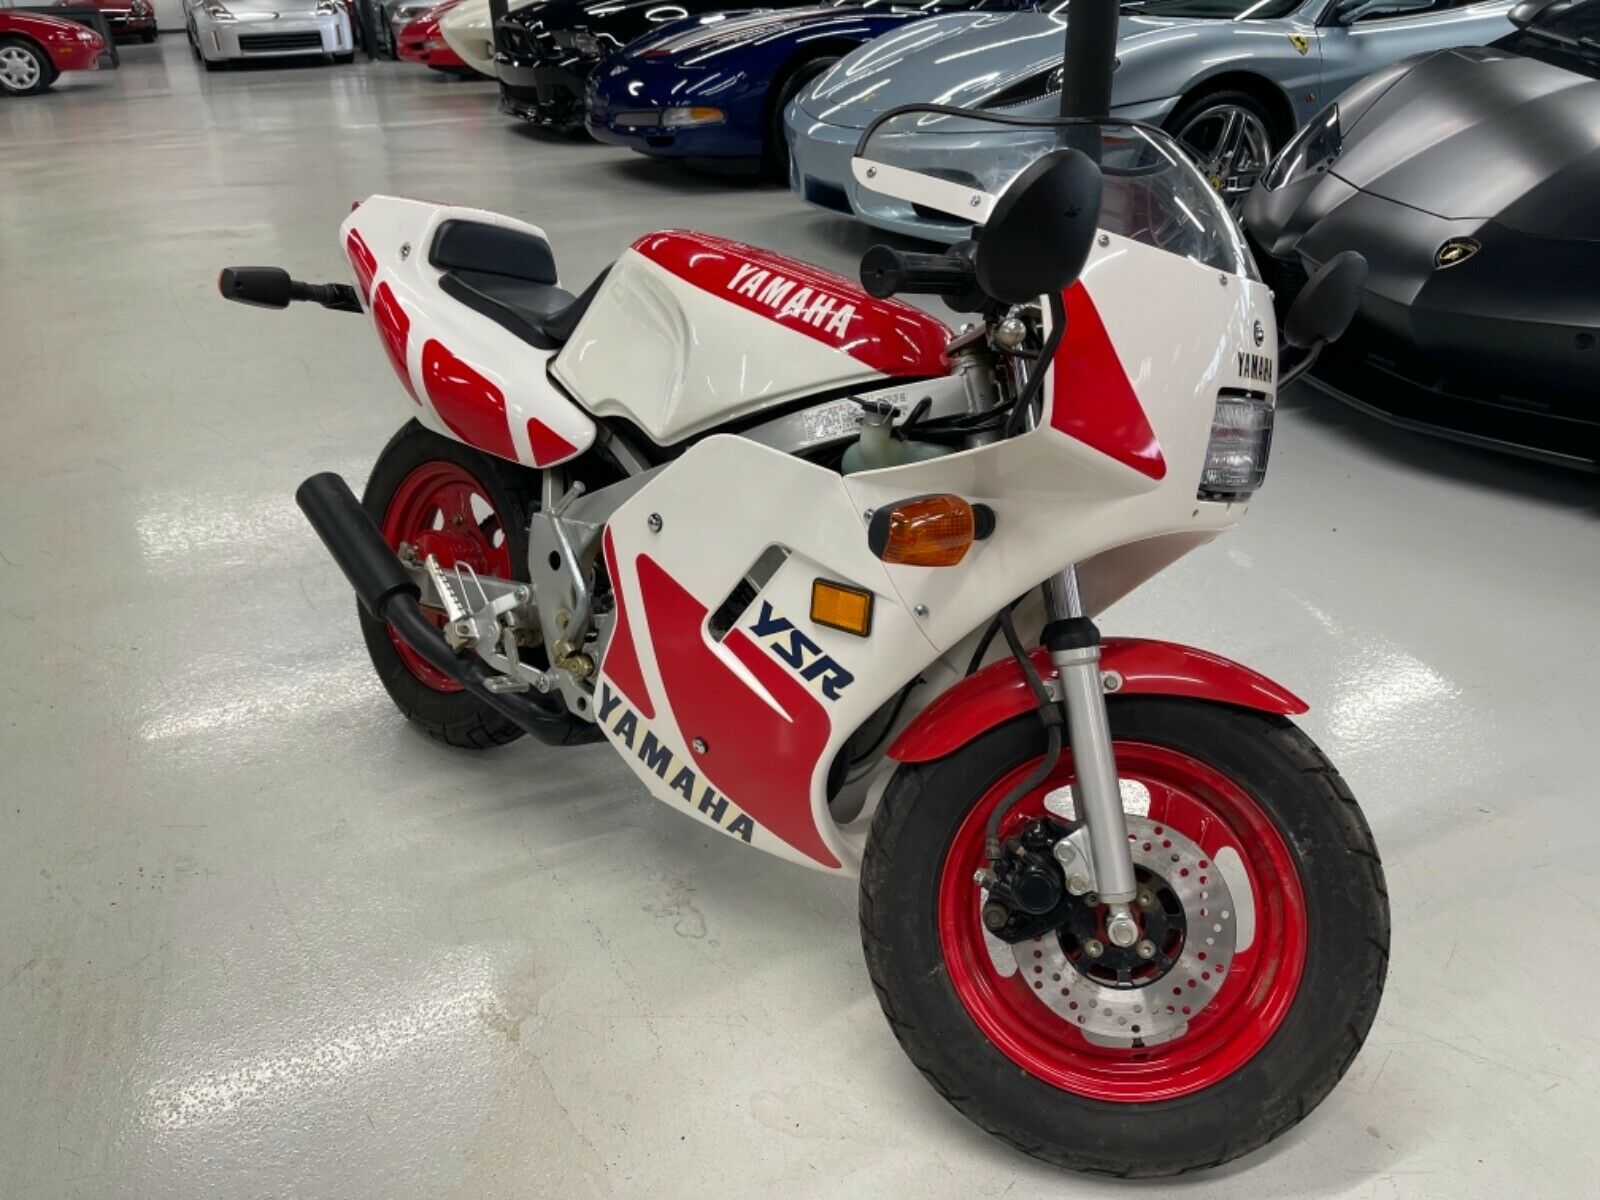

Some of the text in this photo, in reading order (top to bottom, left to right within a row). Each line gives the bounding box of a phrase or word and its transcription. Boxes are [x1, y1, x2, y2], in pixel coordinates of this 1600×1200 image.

[727, 264, 856, 338] YAMAHA
[750, 600, 855, 701] YSR
[598, 683, 755, 843] YAMAHA
